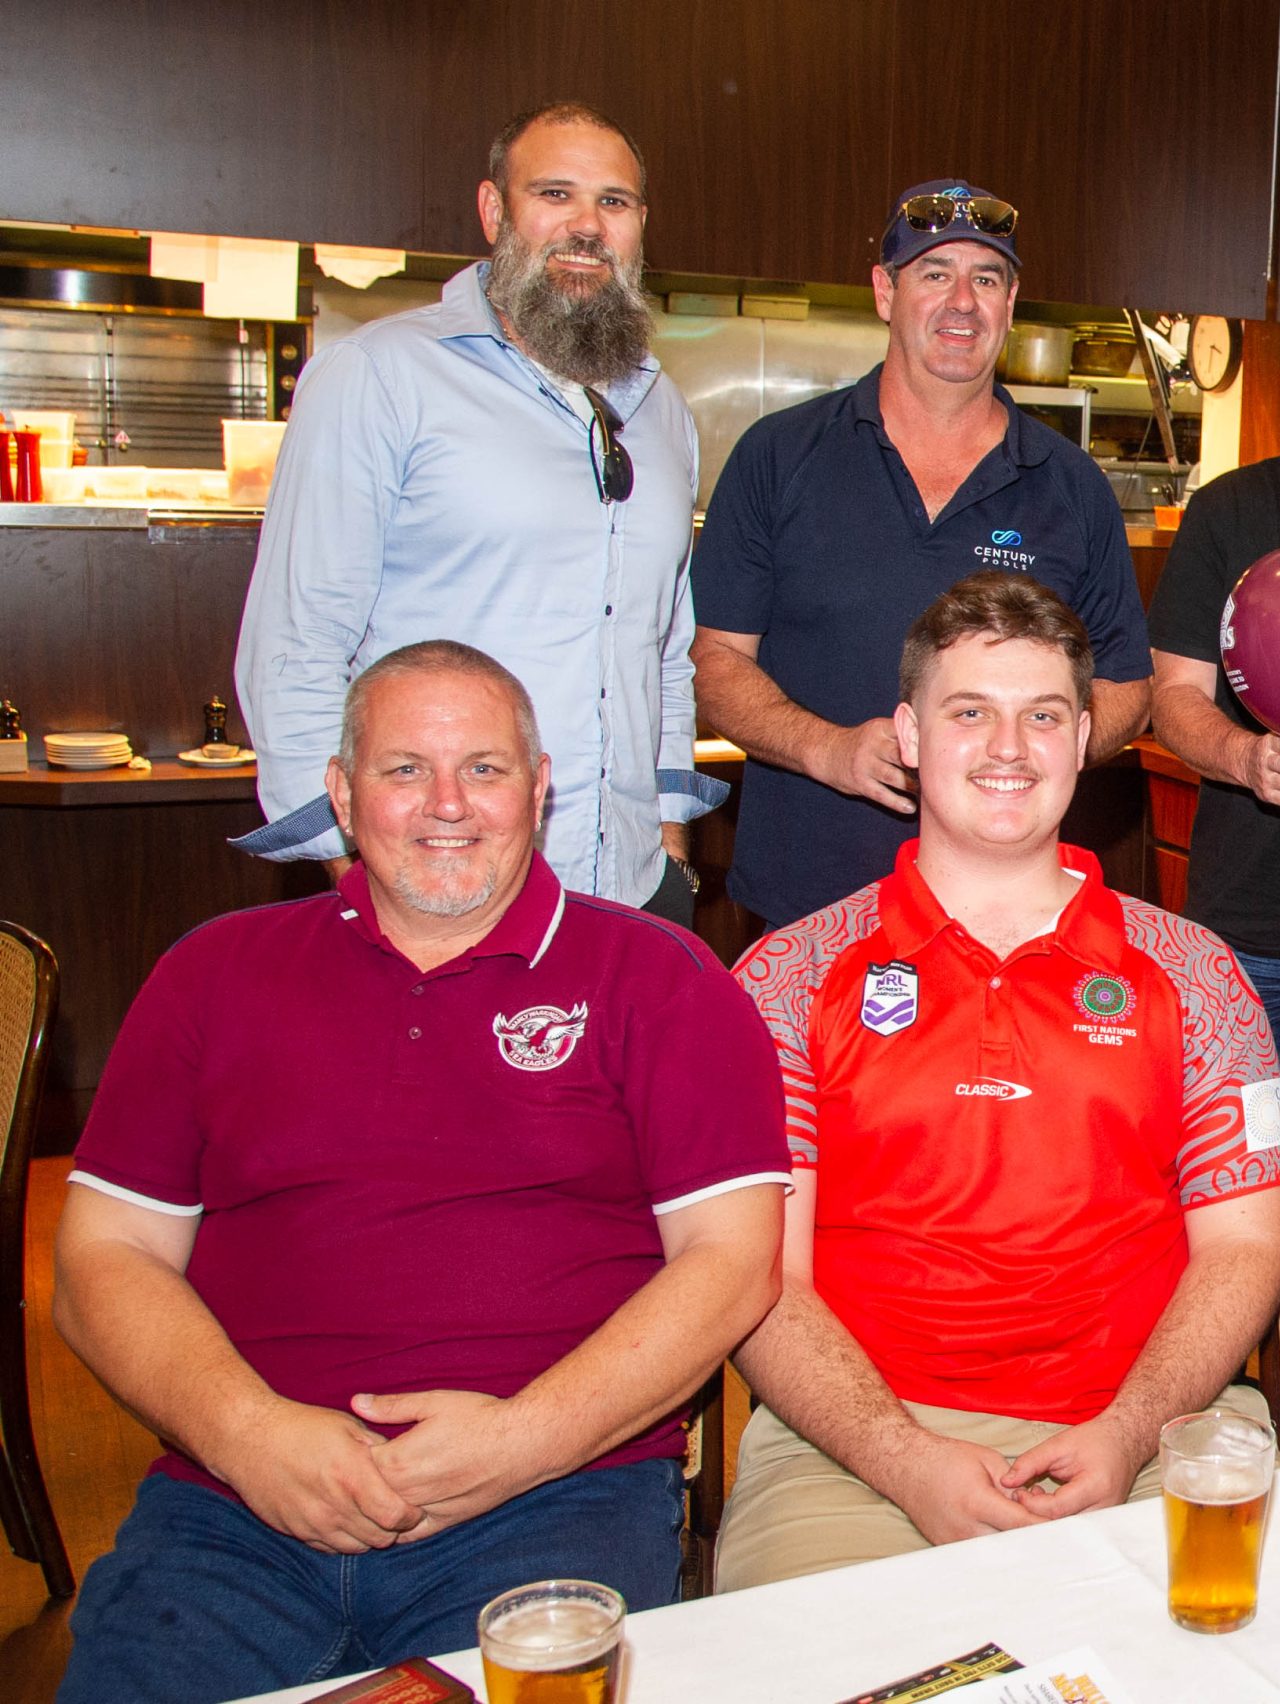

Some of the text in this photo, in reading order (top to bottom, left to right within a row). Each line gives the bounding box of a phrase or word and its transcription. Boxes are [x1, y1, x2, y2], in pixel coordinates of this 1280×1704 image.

[974, 546, 1035, 565] CENTURY
[982, 557, 1027, 571] POOLS
[876, 974, 908, 988] NRL
[1073, 1024, 1137, 1037] FIRST NATIONS
[1088, 1033, 1123, 1046] GEMS
[955, 1083, 1009, 1097] CLASSIC
